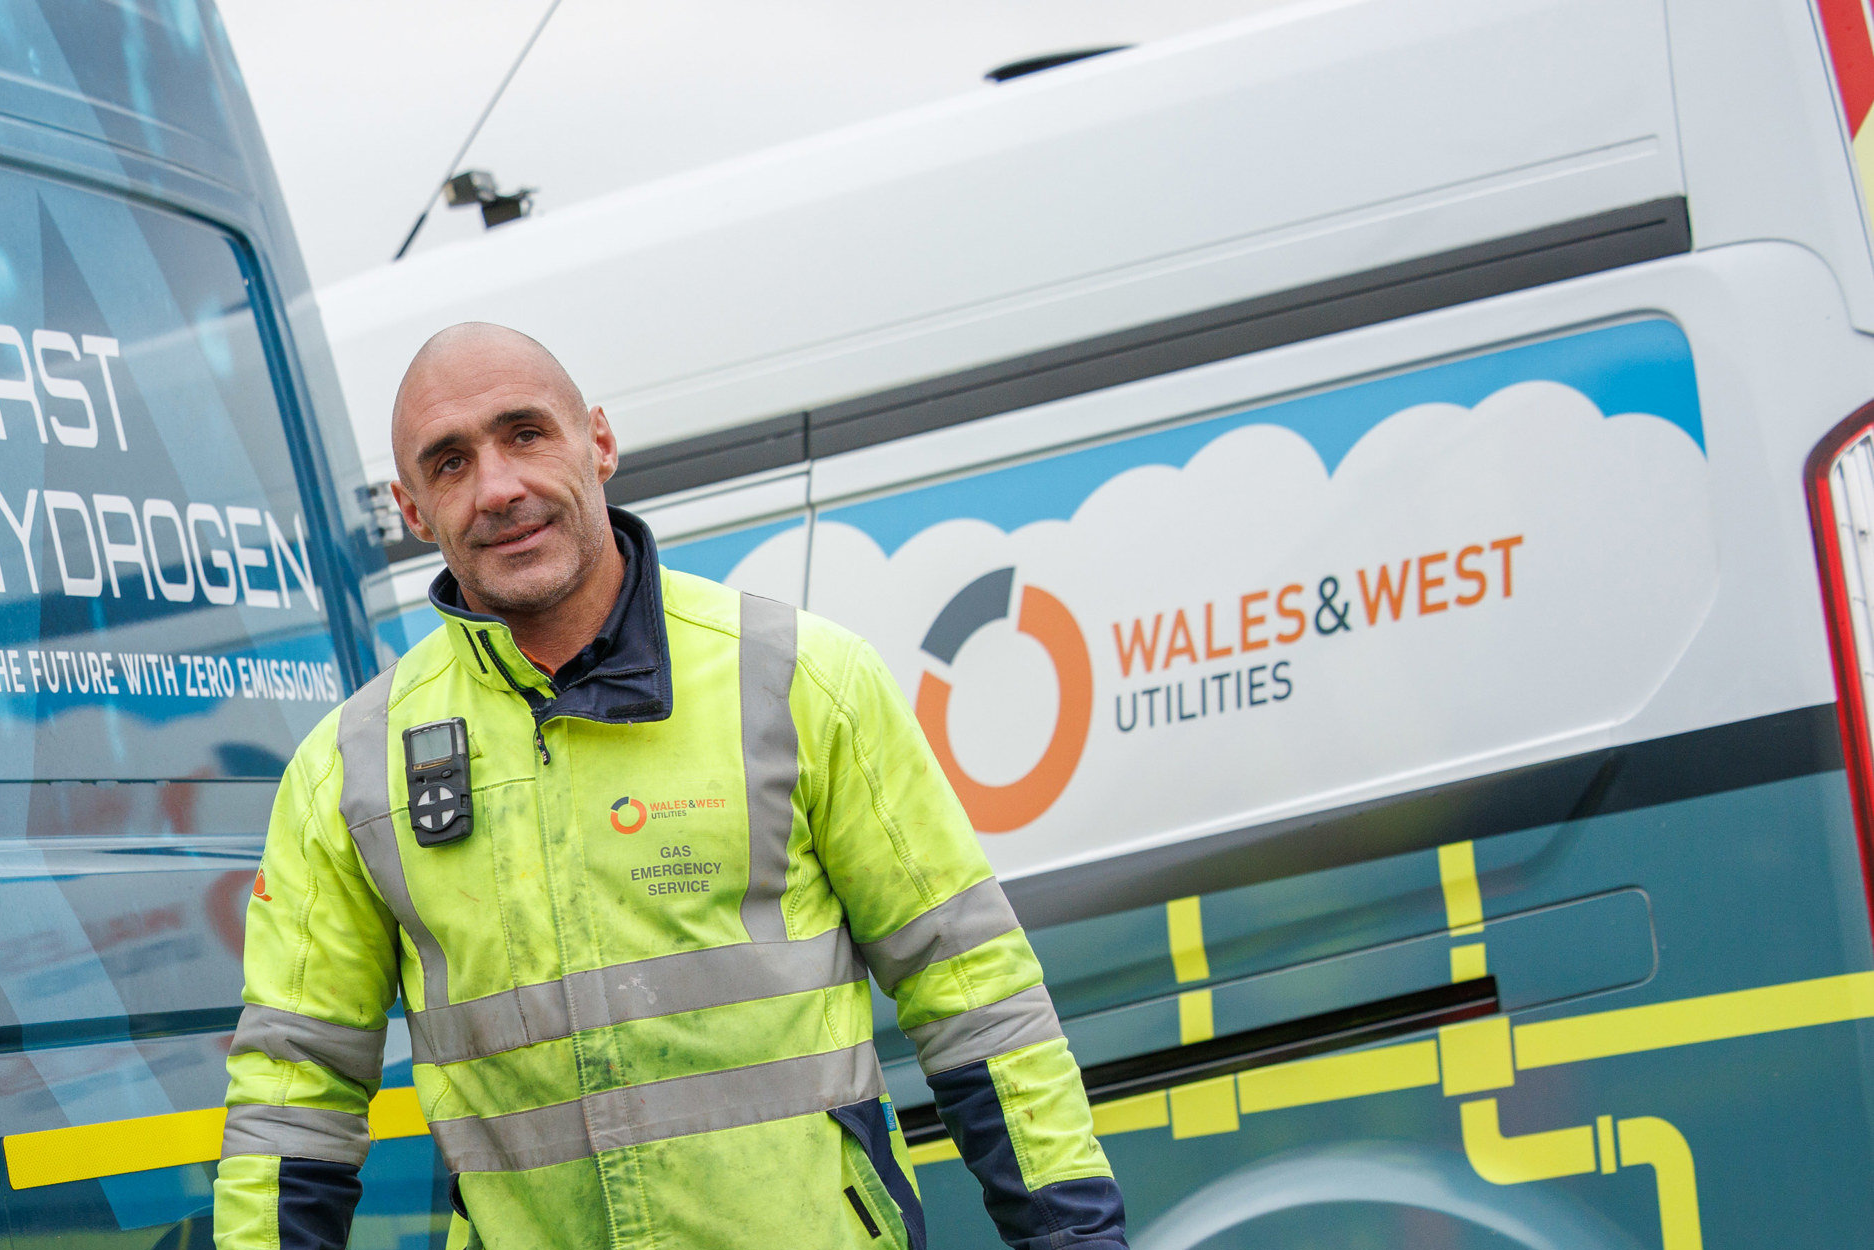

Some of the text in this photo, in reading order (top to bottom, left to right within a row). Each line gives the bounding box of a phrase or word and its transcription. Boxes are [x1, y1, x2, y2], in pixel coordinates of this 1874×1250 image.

[1112, 534, 1524, 678] WALES&WEST
[30, 649, 119, 695] FUTURE
[120, 652, 180, 697] WITH
[179, 655, 236, 698] ZERO
[238, 658, 338, 703] EMISSIONS
[1115, 660, 1293, 733] UTILITIES
[649, 799, 726, 812] WALES&WEST
[651, 809, 687, 820] UTILITIES
[660, 845, 692, 859] GAS
[631, 862, 722, 881] EMERGENCY
[648, 880, 710, 896] SERVICE
